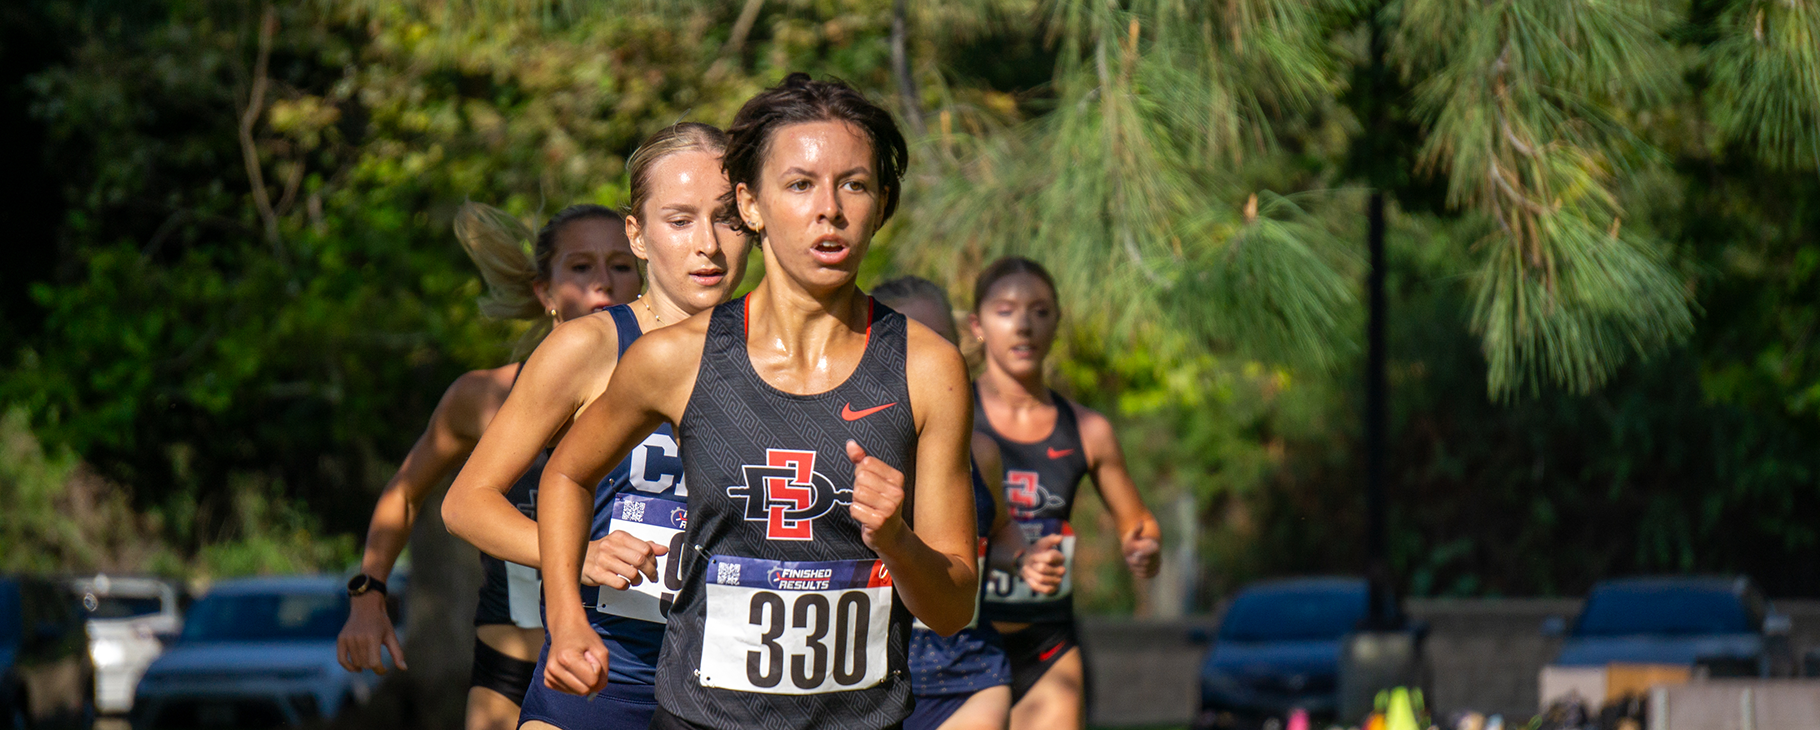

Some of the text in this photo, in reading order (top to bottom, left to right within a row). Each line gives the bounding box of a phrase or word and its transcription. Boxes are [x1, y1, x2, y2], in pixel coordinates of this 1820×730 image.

[781, 568, 832, 579] FINISHED
[778, 580, 830, 590] RESULTS
[746, 590, 871, 690] 330
